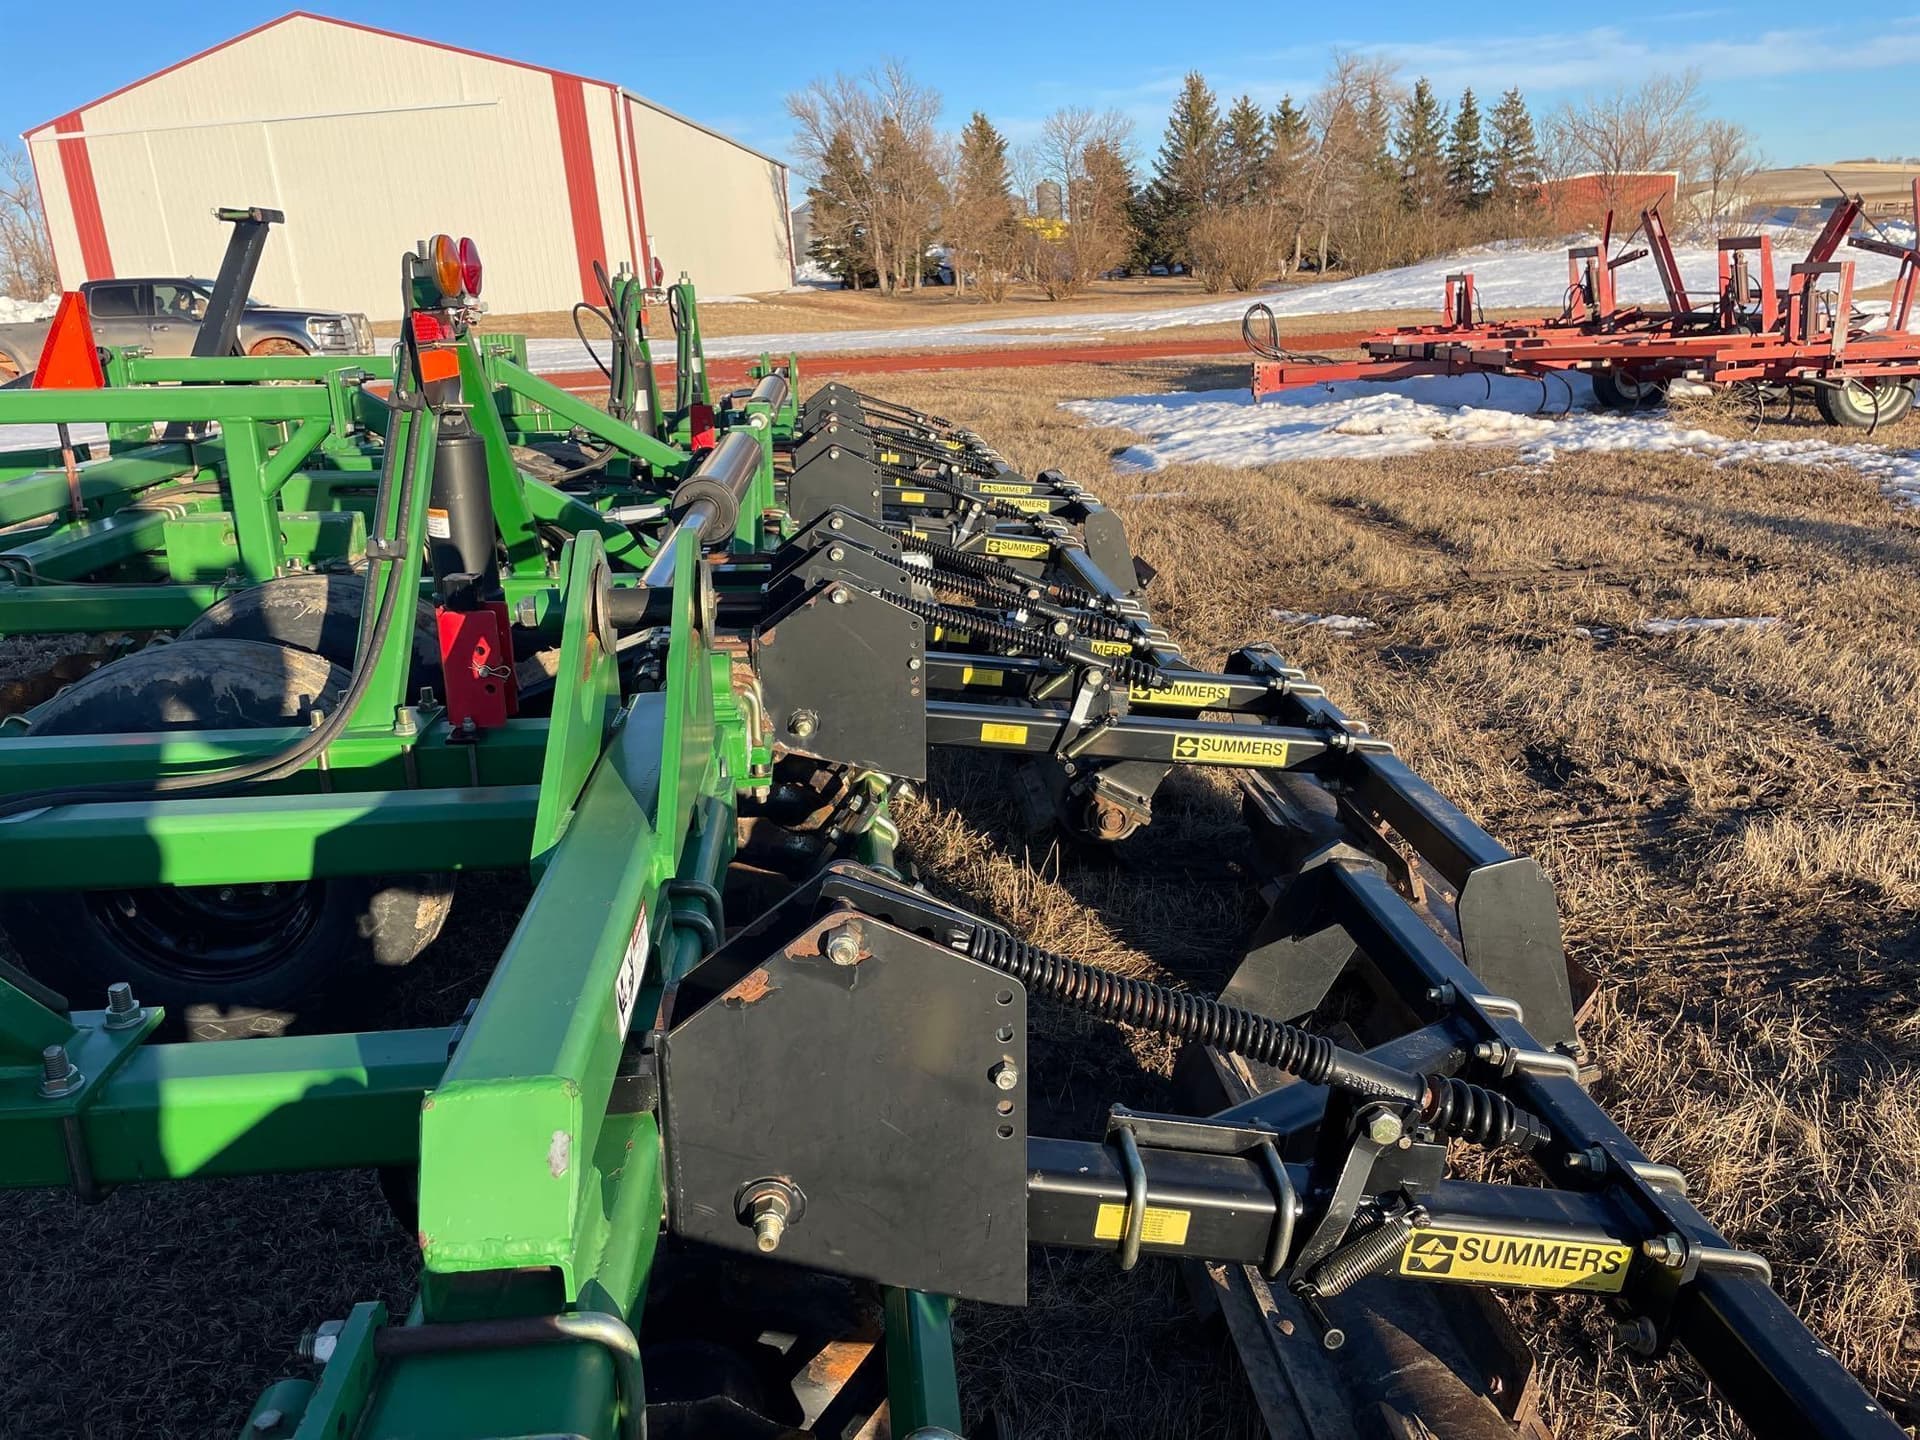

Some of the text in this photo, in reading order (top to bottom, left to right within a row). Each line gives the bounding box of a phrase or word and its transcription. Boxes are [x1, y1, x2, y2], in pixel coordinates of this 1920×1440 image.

[991, 485, 1030, 494] SUMMERS
[1001, 541, 1048, 553] SUMMERS
[1092, 643, 1129, 656] MERS
[1200, 738, 1283, 756] SUMMERS
[1459, 1236, 1622, 1275] SUMMERS
